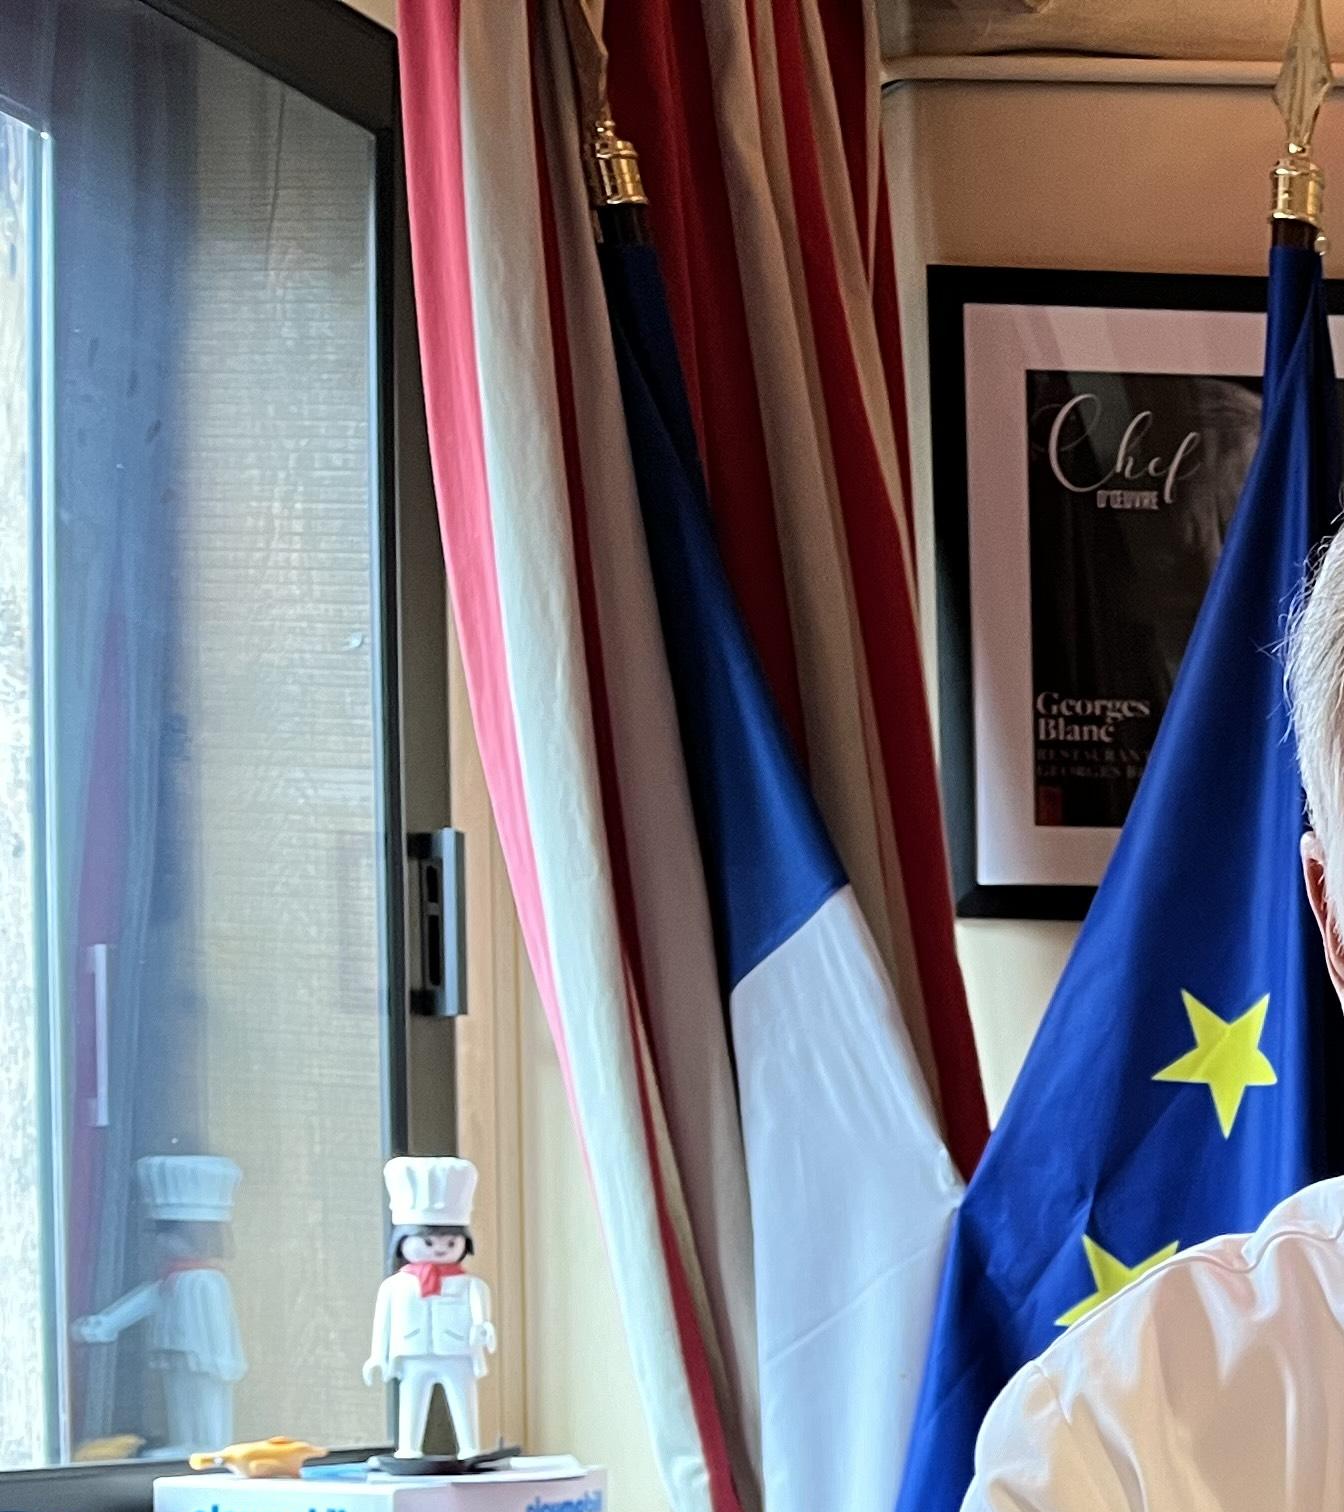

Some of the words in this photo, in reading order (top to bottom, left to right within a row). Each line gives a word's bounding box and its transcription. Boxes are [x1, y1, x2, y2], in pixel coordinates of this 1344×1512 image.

[1048, 392, 1201, 504] Chef
[1036, 691, 1150, 722] Georges
[1038, 716, 1114, 743] Blanc
